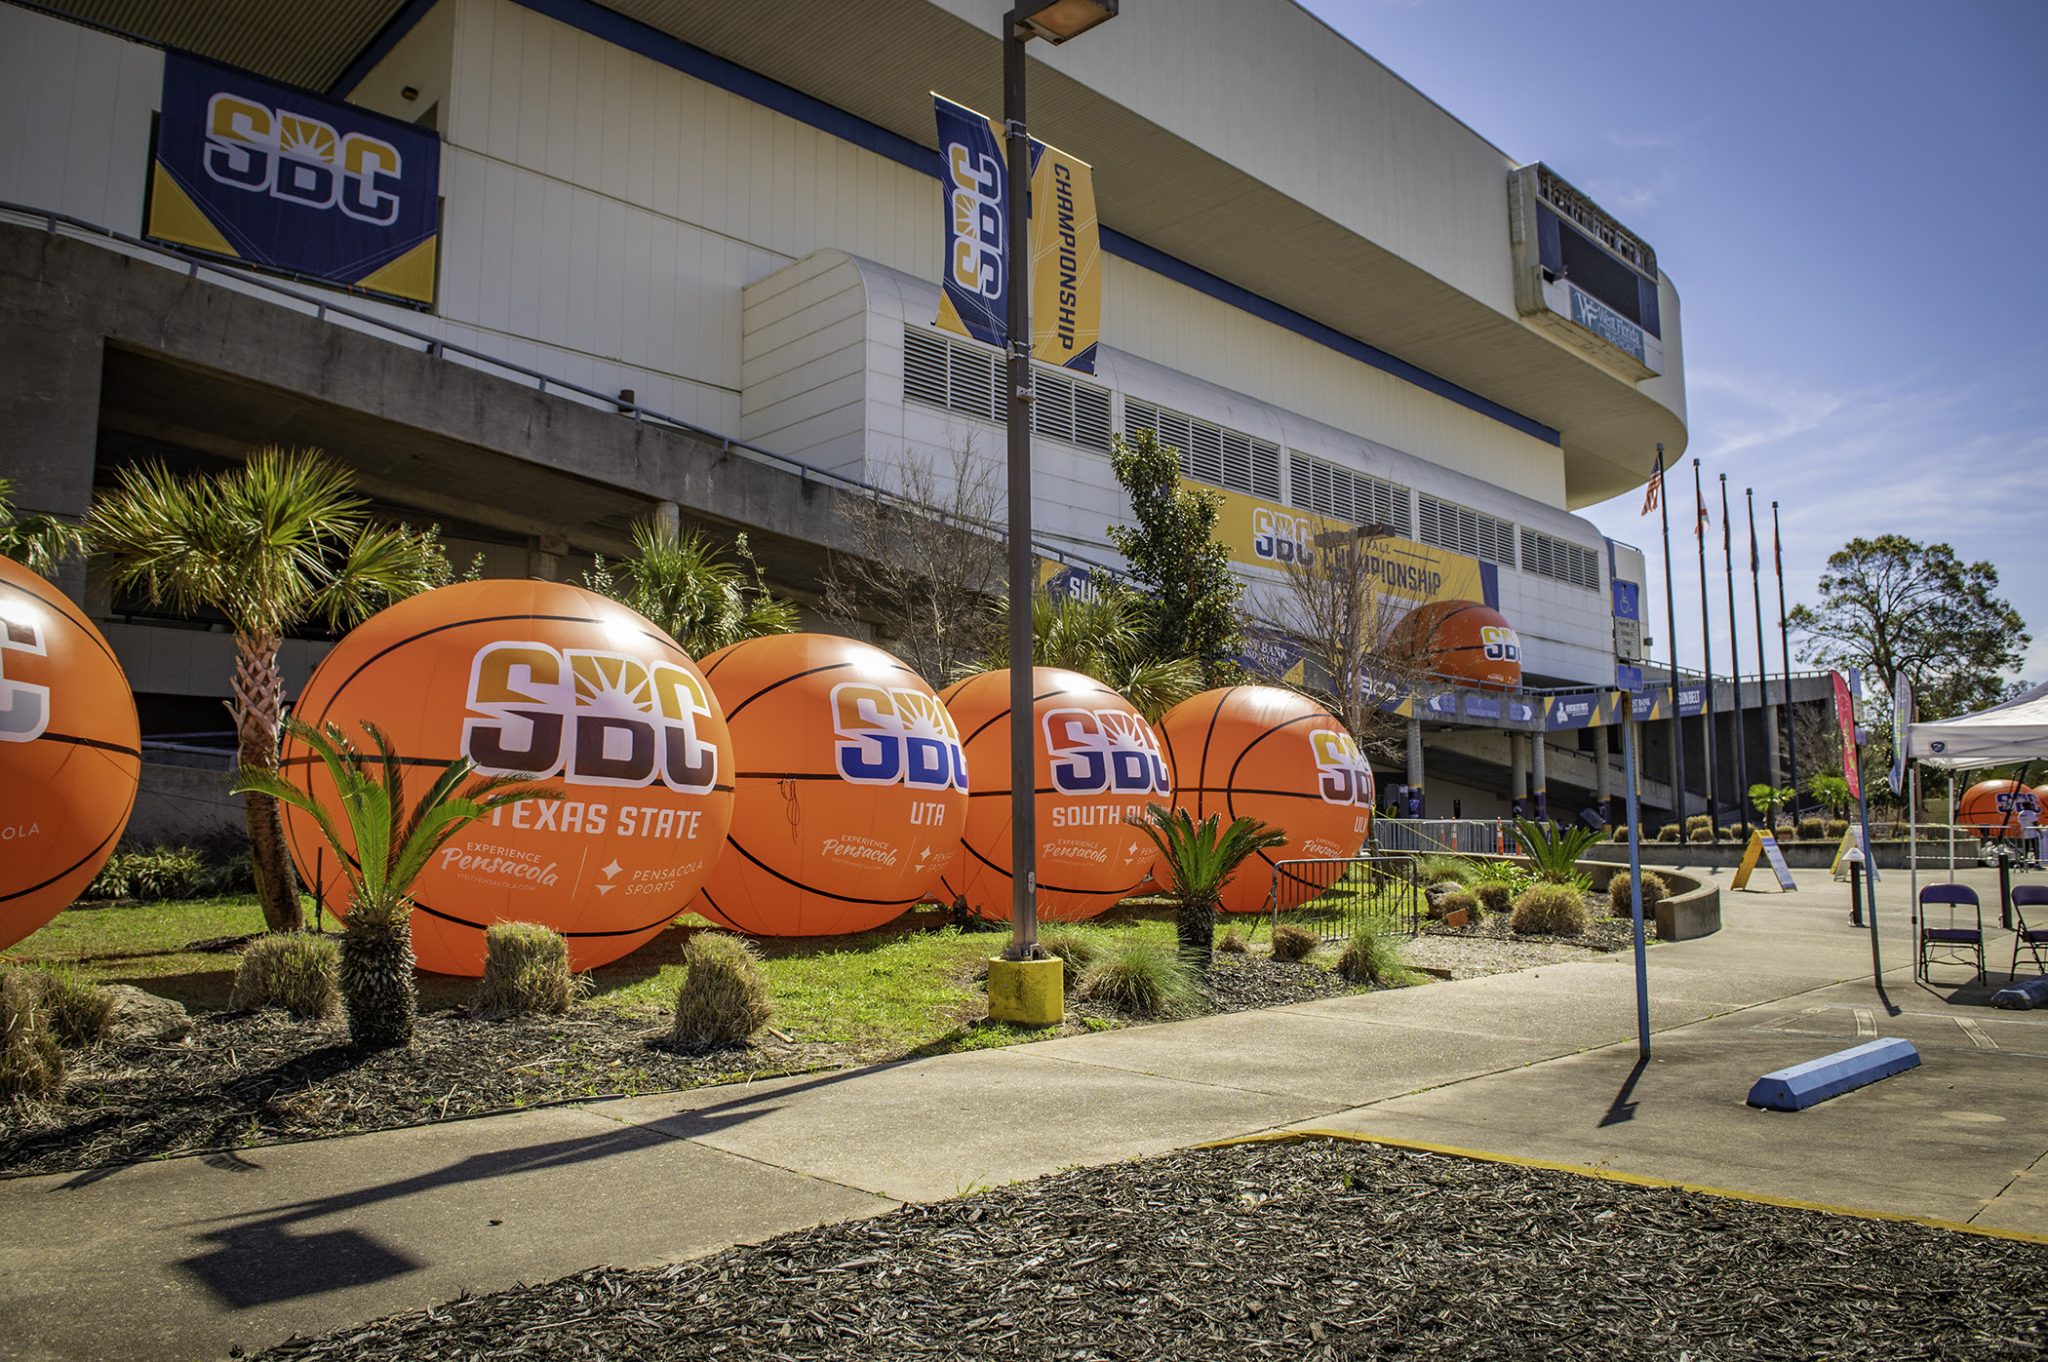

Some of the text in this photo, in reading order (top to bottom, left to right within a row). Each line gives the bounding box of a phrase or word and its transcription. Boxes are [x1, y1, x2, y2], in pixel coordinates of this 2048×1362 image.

[203, 92, 401, 226] SBC
[948, 142, 1003, 300] SBC
[1054, 162, 1077, 350] CHAMPIONSHIP
[1253, 507, 1315, 568] SBC
[460, 640, 718, 796] SBC
[487, 795, 702, 839] TEXAS STATE
[910, 800, 946, 826] UTA
[1052, 804, 1120, 828] SOUTH
[466, 841, 542, 864] EXPERIENCE
[821, 838, 898, 867] Pensacola
[841, 834, 891, 850] EXPERIENCE
[1042, 843, 1107, 863] Pensacola
[441, 847, 559, 887] Pensacola
[631, 860, 703, 883] PENSACOLA
[624, 880, 676, 896] SPORTS
